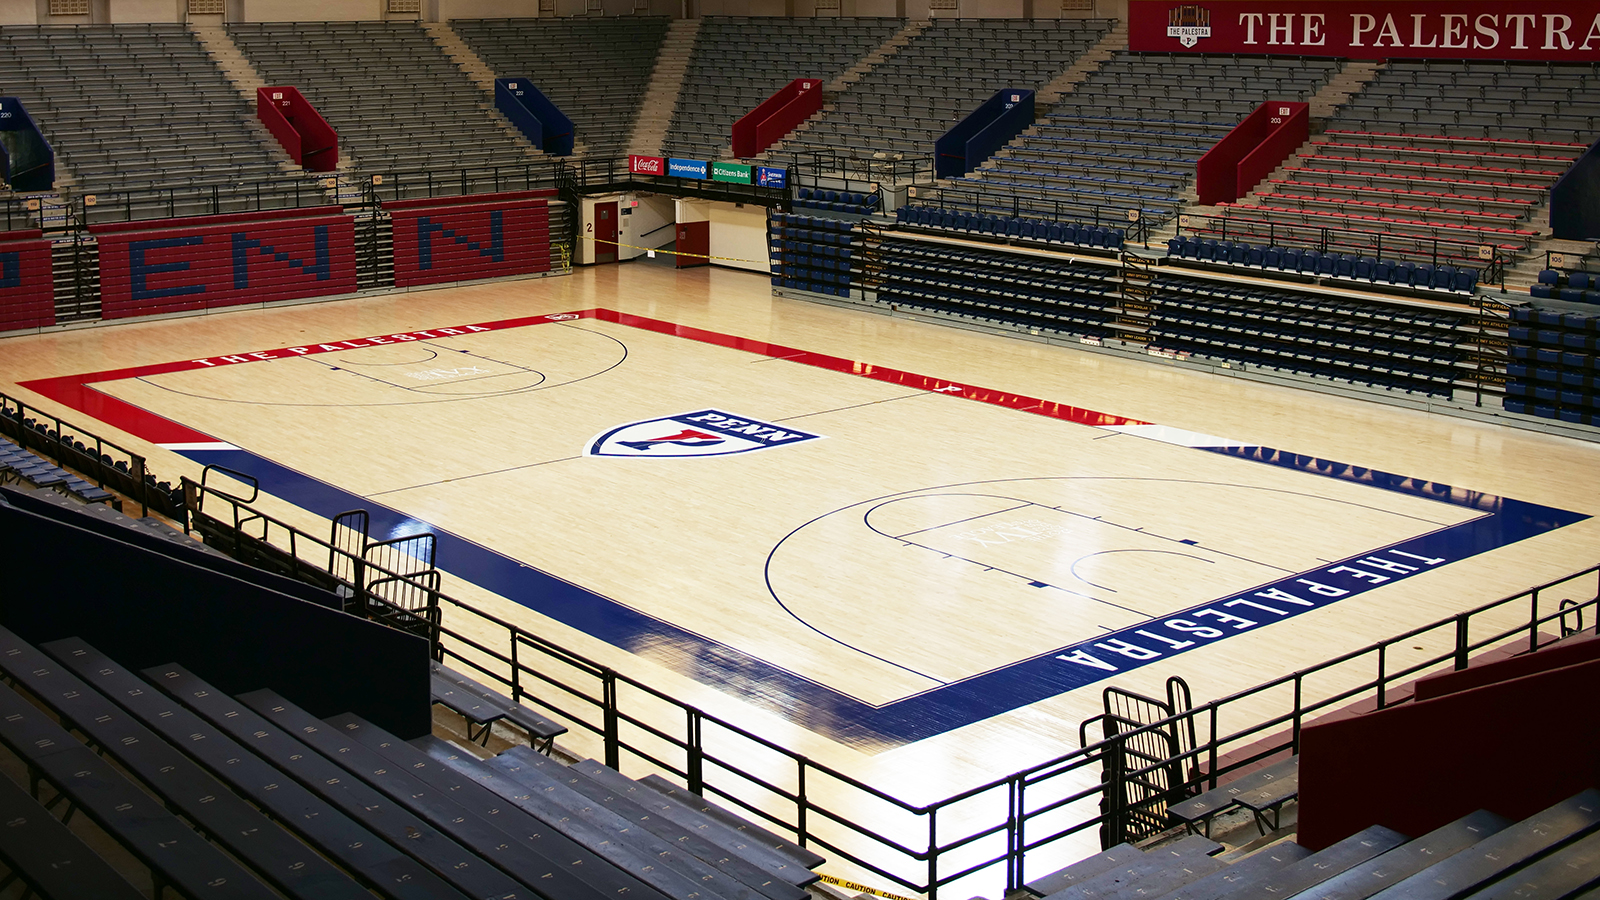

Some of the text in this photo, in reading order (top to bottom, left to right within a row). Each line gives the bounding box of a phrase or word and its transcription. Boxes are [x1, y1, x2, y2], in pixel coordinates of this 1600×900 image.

[1239, 13, 1600, 50] THE PALESTRA
[670, 163, 700, 173] Independence
[718, 168, 749, 178] Citizens Bank
[586, 223, 593, 232] 2
[192, 323, 490, 369] THE PALESTRA
[686, 412, 804, 442] PENN
[614, 428, 726, 451] P
[1055, 549, 1446, 673] THE PALESTRA
[845, 881, 876, 895] CAUTION
